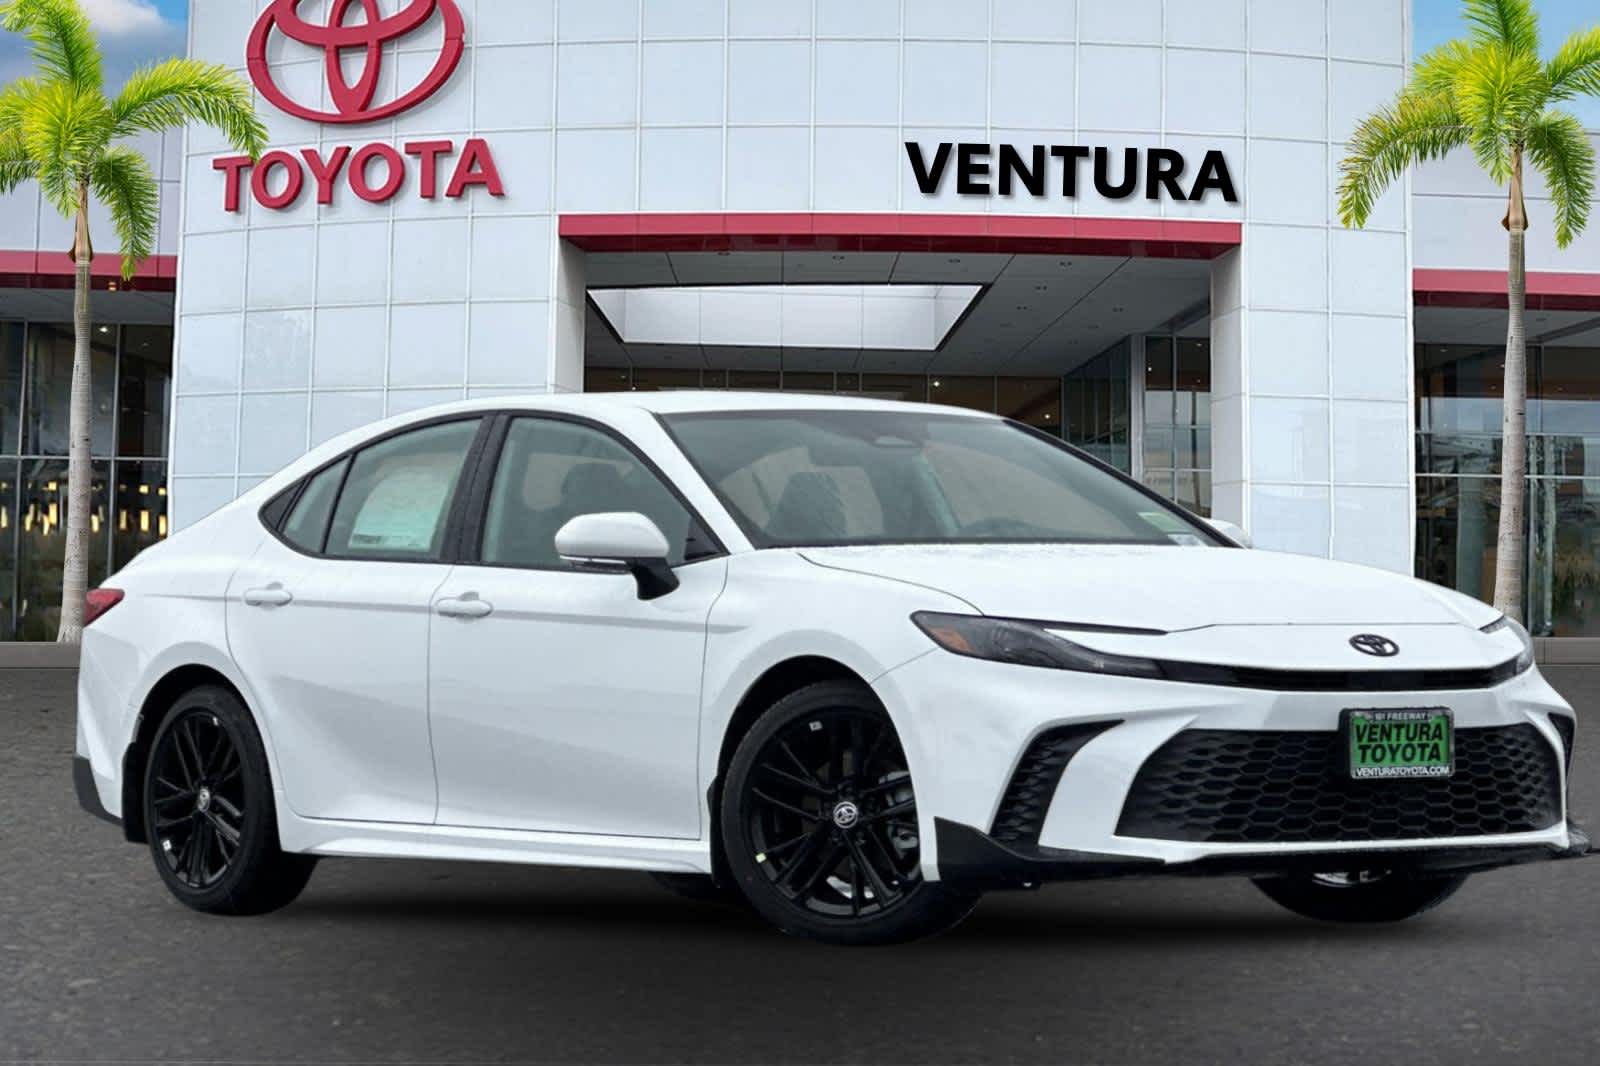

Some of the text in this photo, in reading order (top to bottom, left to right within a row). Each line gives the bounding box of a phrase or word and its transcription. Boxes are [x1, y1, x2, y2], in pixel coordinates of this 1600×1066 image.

[212, 138, 505, 212] TOYOTA
[904, 142, 1239, 203] VENTURA
[1356, 722, 1443, 742] VENTURA
[1358, 743, 1441, 763] TOYOTA
[1356, 766, 1450, 777] VENTURATOYOTA.COM
